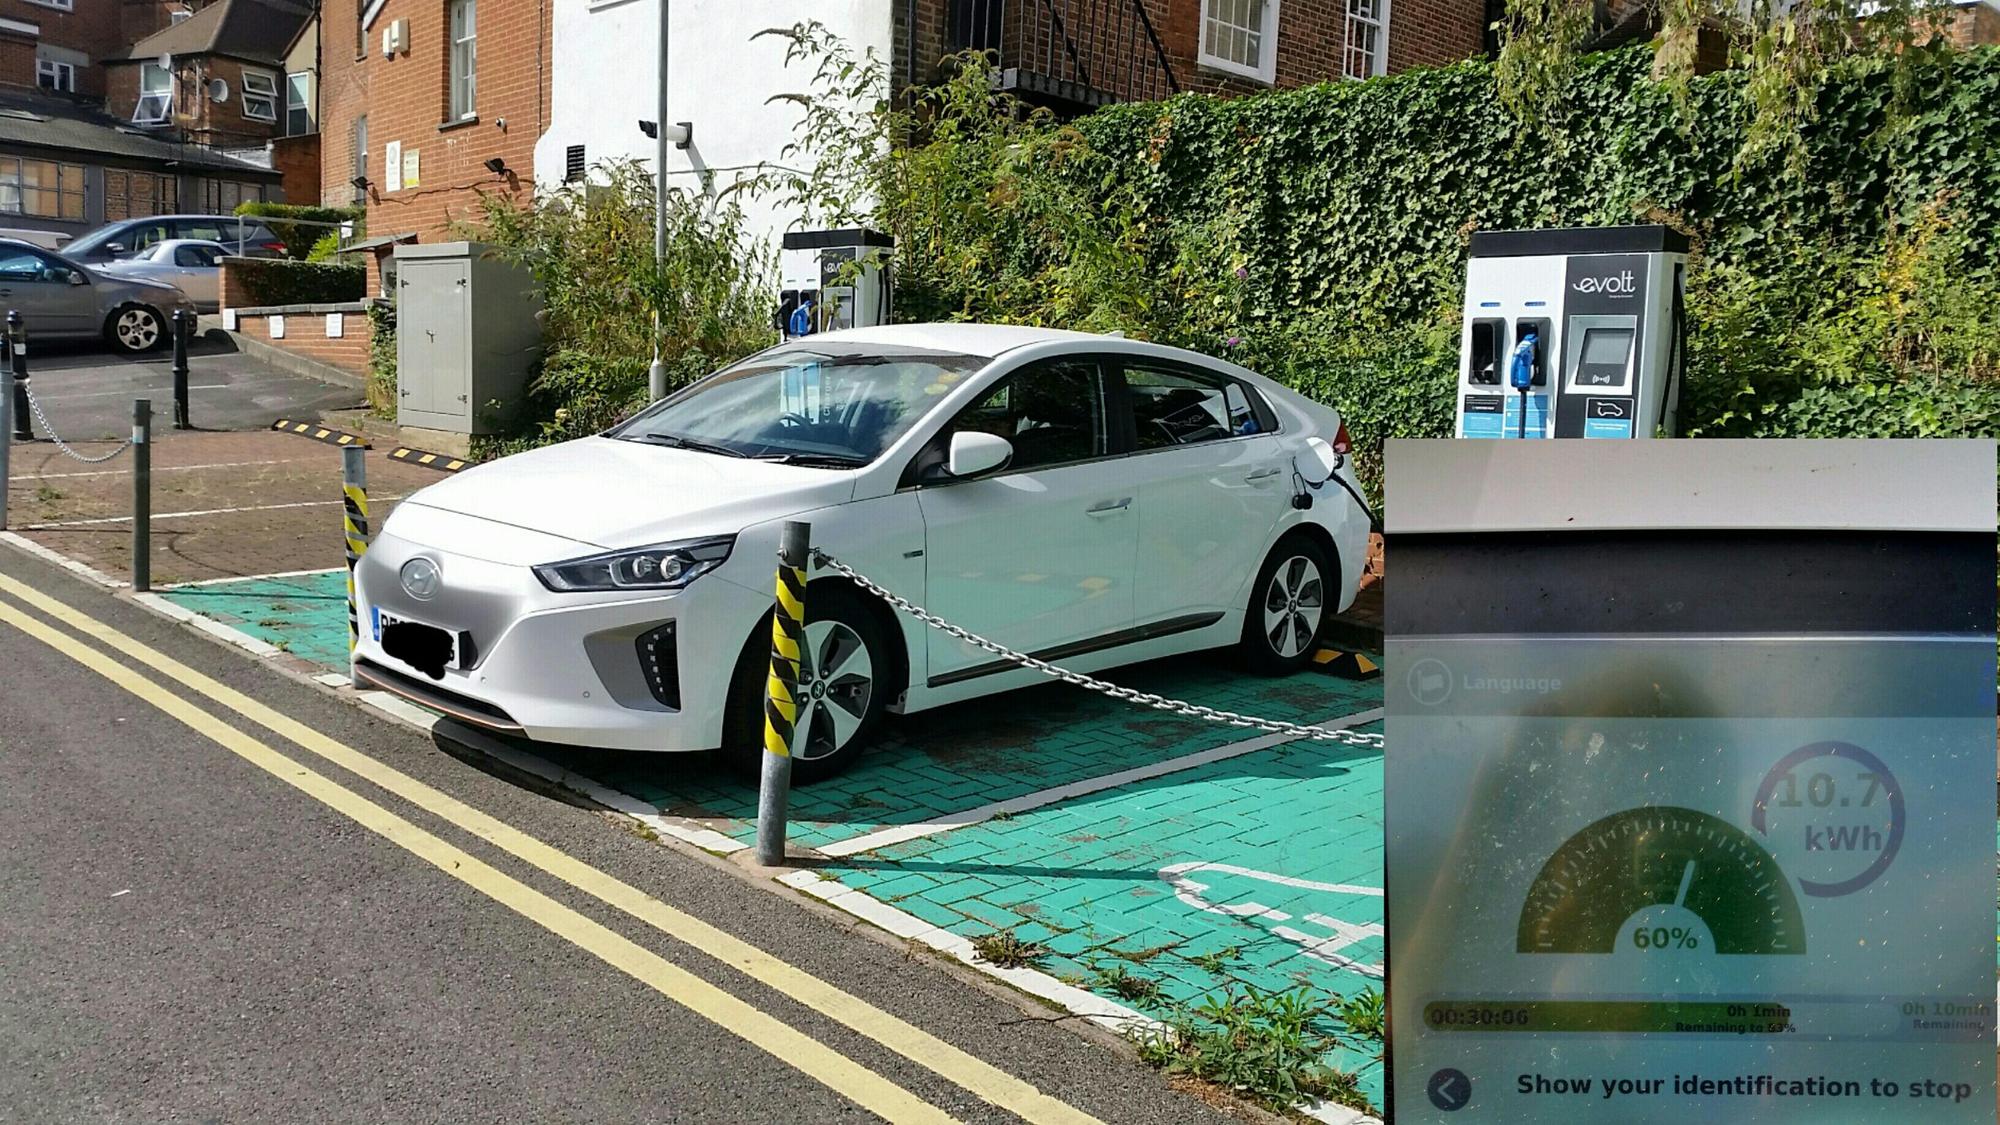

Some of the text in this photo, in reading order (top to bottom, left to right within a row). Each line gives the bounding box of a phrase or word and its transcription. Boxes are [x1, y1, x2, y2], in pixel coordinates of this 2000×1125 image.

[1573, 270, 1636, 293] evolt
[1463, 674, 1561, 694] Language
[1776, 772, 1881, 808] 10.7
[1805, 825, 1882, 851] kWh
[1633, 927, 1698, 949] 60%
[1431, 1008, 1529, 1025] 00:30:06
[1727, 1003, 1791, 1017] 0h 1min
[1903, 1002, 1991, 1016] 0h 10min
[1675, 1023, 1746, 1035] Remaining
[1750, 1023, 1764, 1033] to
[1913, 1020, 1985, 1032] Remaining
[1517, 1074, 1972, 1103] Show your identification to stop
